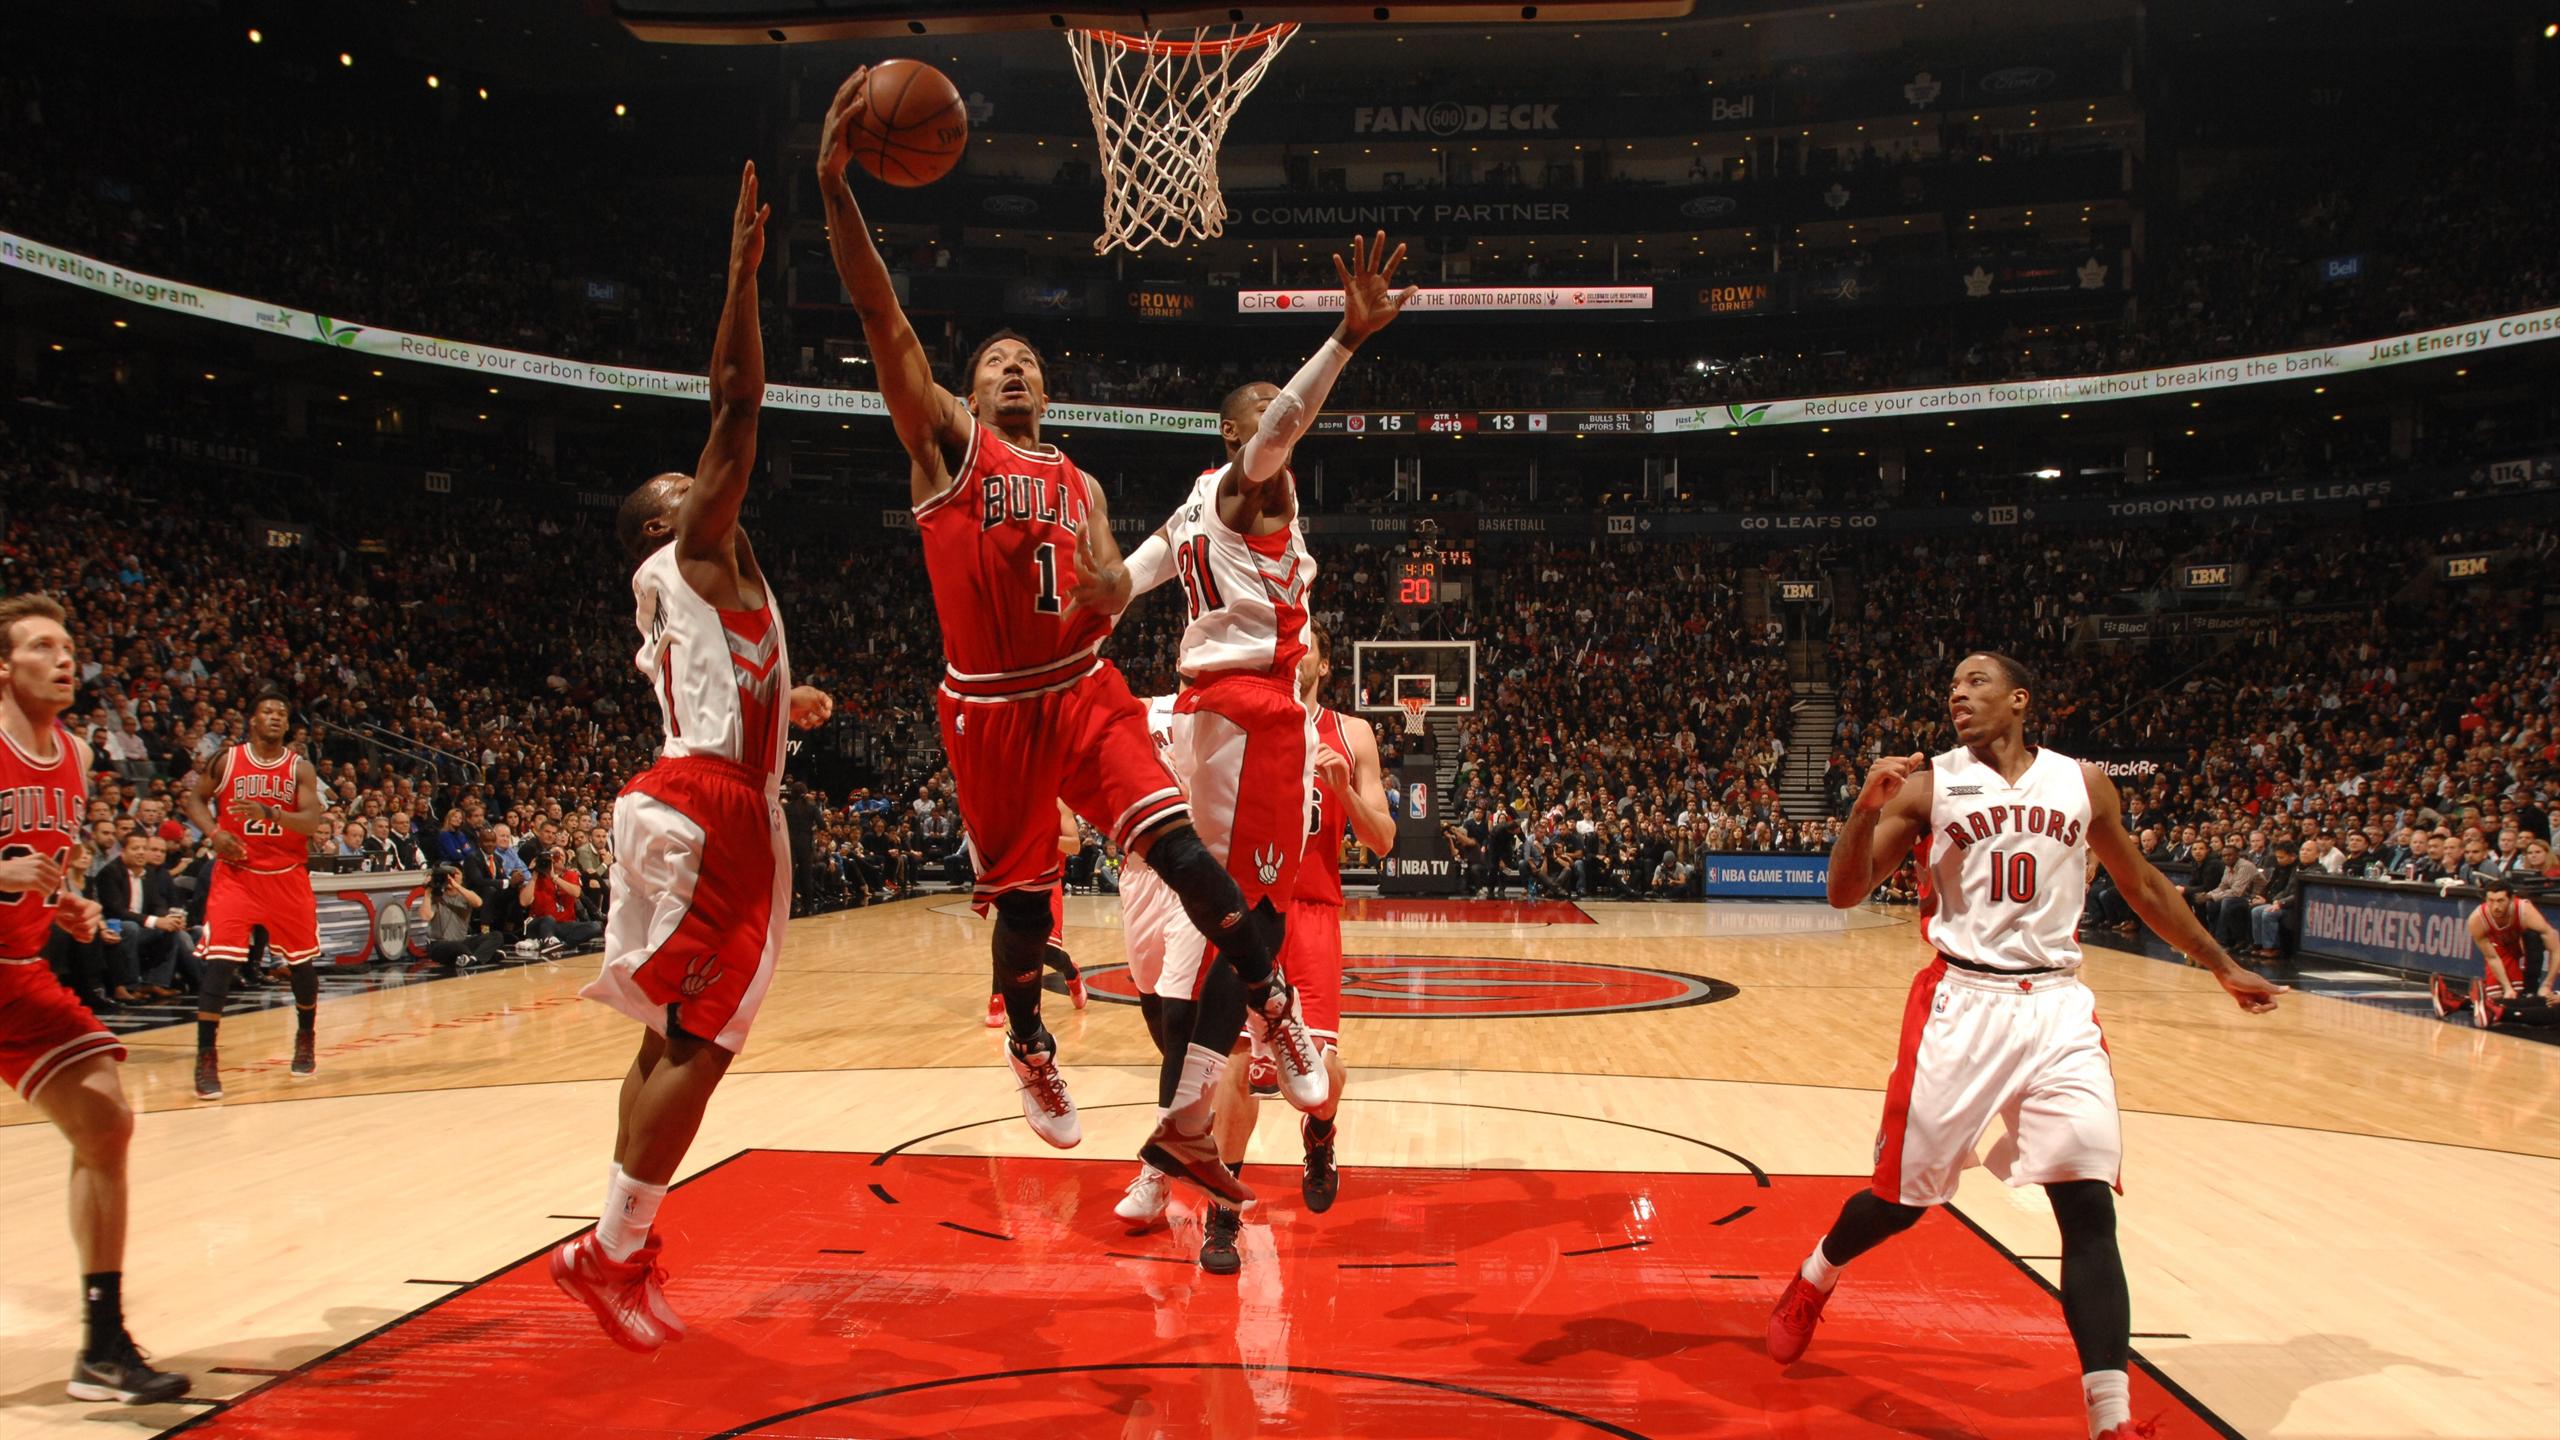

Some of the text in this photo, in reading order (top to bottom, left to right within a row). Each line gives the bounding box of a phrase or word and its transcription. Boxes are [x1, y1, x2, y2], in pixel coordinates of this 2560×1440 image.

[1711, 95, 1754, 121] Bell
[1354, 104, 1559, 133] FAN 600 DECK
[1251, 205, 1424, 225] COMMUNITY
[1434, 203, 1571, 222] PARTNER
[0, 240, 205, 309] nservation Program.
[2328, 258, 2357, 276] Bell
[1128, 292, 1195, 308] CROWN
[1318, 296, 1344, 307] OFFIC
[1410, 295, 1422, 306] OF
[1426, 294, 1445, 306] THE
[1449, 293, 1494, 305] TORONTO
[1497, 293, 1542, 305] RAPTORS
[1698, 285, 1768, 304] CROWN
[1139, 307, 1184, 318] CORNER
[1711, 300, 1755, 312] CORNER
[2369, 341, 2410, 361] Just
[2416, 327, 2492, 353] Energy
[400, 336, 885, 410] Reduce your carbon footprint with eaking the ba
[1804, 352, 2340, 416] Reduce your carbon footprint without breaking the bank.
[1378, 415, 1401, 431] 15
[1491, 415, 1515, 430] 13
[1589, 413, 1652, 423] BULLS STL 0
[1675, 416, 1692, 427] just
[1430, 421, 1462, 432] 4:19
[1578, 422, 1652, 431] RAPTORS STL 0
[2495, 464, 2525, 482] 116
[427, 474, 450, 490] 111
[577, 491, 626, 507] TORONT
[2107, 480, 2392, 518] TORONTO MAPLE LEAFS
[884, 512, 907, 526] 112
[1740, 515, 1877, 530] GO LEAFS GO
[1991, 508, 2015, 523] 115
[1111, 518, 1146, 532] ORTH
[1370, 518, 1407, 531] TORON
[1478, 517, 1546, 532] BASKETBALL
[1610, 519, 1633, 532] 114
[1440, 551, 1470, 559] THE
[1405, 563, 1434, 577] 4:19
[2447, 557, 2489, 577] IBM
[1033, 541, 1062, 616] 1
[1177, 534, 1226, 621] 31
[2190, 568, 2227, 586] IBM
[1400, 577, 1431, 604] 20
[1782, 584, 1814, 598] IBM
[2096, 760, 2159, 777] BlackBe
[234, 774, 295, 805] BULLS
[0, 786, 84, 845] BULLS
[1944, 804, 2081, 850] RAPTORS
[1402, 860, 1449, 875] NBA TV
[1721, 869, 1746, 883] NBA
[1748, 869, 1783, 883] GAME
[1784, 869, 1814, 884] TIME
[1990, 851, 2036, 904] 10
[2311, 901, 2474, 960] NBATICKETS.COM
